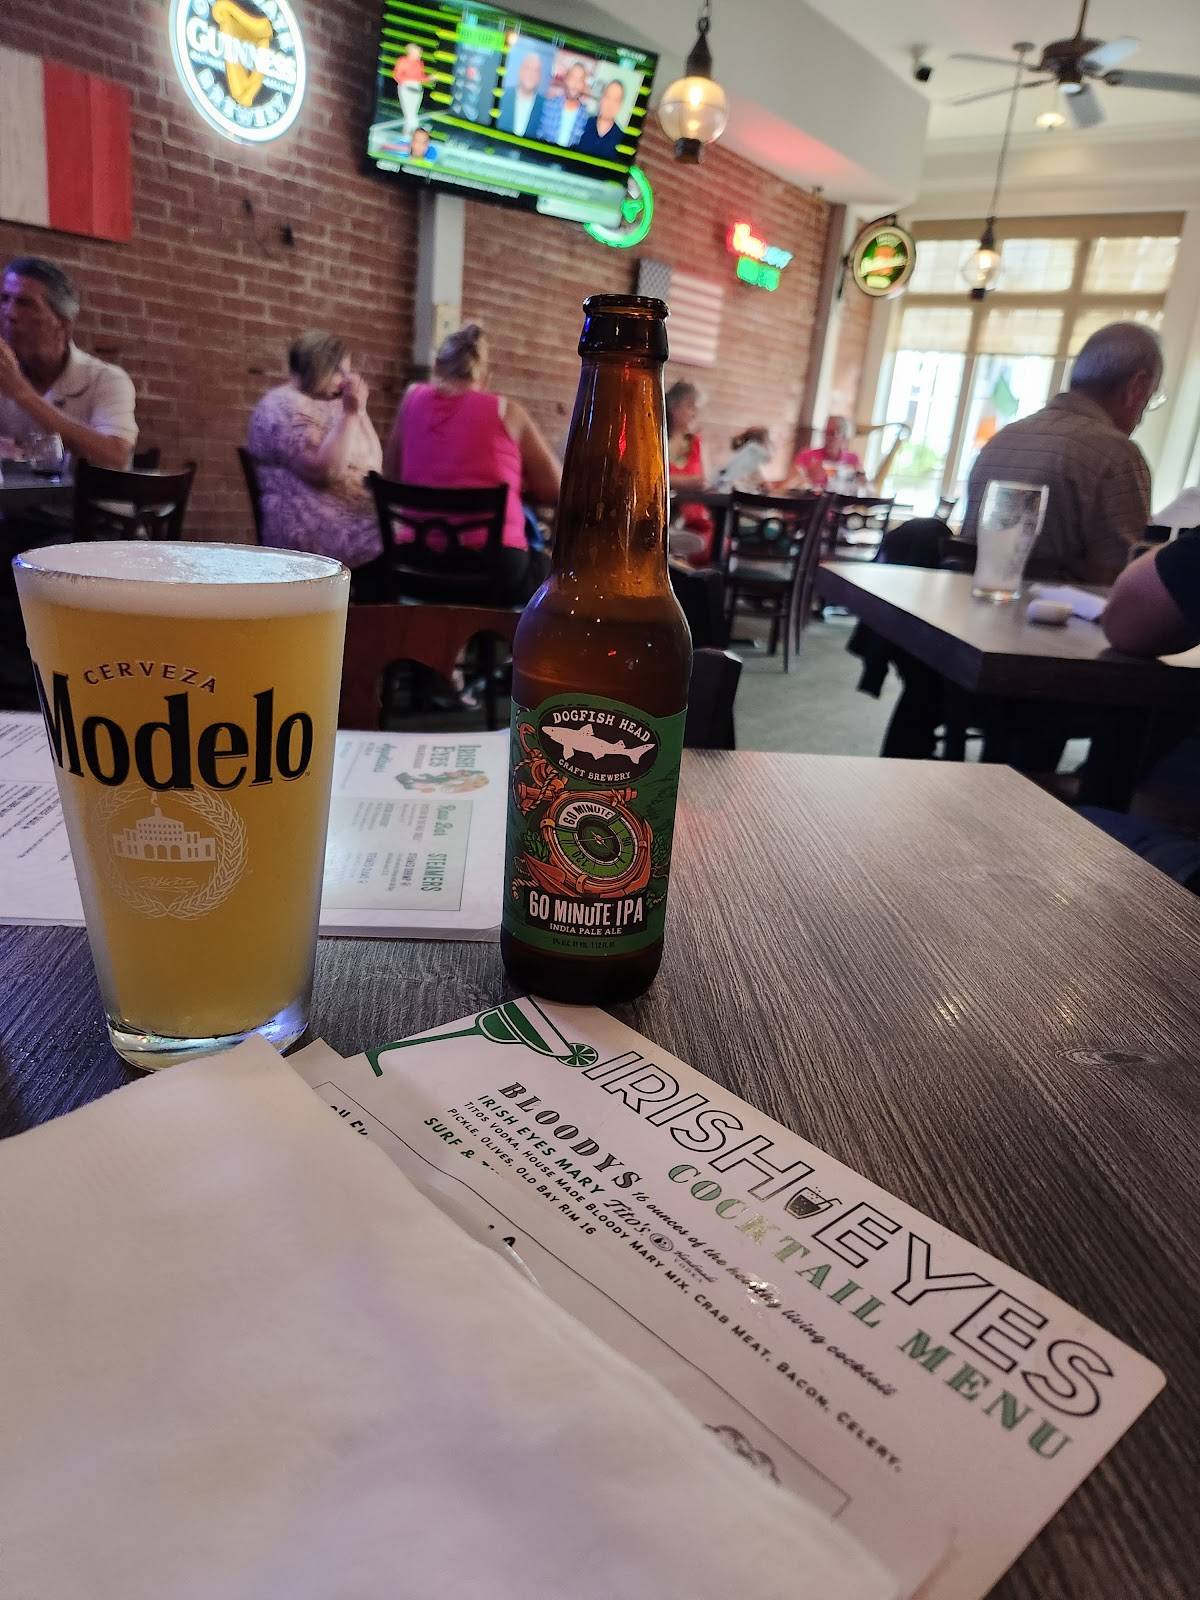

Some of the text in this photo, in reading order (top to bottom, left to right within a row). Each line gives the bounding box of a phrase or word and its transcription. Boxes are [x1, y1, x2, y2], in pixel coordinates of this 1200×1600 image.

[187, 17, 297, 84] GUINNESS
[84, 661, 217, 694] CERVEZA
[32, 661, 314, 791] Modelo
[552, 709, 651, 742] DOGFISH HEAD
[429, 744, 456, 768] EYES
[455, 744, 482, 768] IRISH
[558, 758, 631, 782] CRAFT BREWERY
[562, 804, 613, 825] 60 MINUTE
[420, 852, 448, 892] STEAMERS
[529, 890, 643, 926] 60 MINUTE IPA
[550, 922, 623, 936] INDIA PALE ALE
[424, 1117, 475, 1159] SURF &
[478, 1095, 518, 1126] IRISH
[517, 1126, 556, 1156] EYES
[555, 1158, 606, 1195] MARY
[603, 1199, 651, 1234] Tito's
[498, 1082, 642, 1188] BLOODYS
[632, 1191, 650, 1202] 16
[646, 1204, 688, 1236] ounces
[688, 1237, 707, 1248] of
[703, 1249, 727, 1266] the
[782, 1310, 827, 1345] living
[826, 1345, 898, 1396] cocktail
[579, 1222, 597, 1236] 16
[581, 1050, 1115, 1419] IRISH EYES
[667, 1163, 1075, 1462] COCKTAIL MENU
